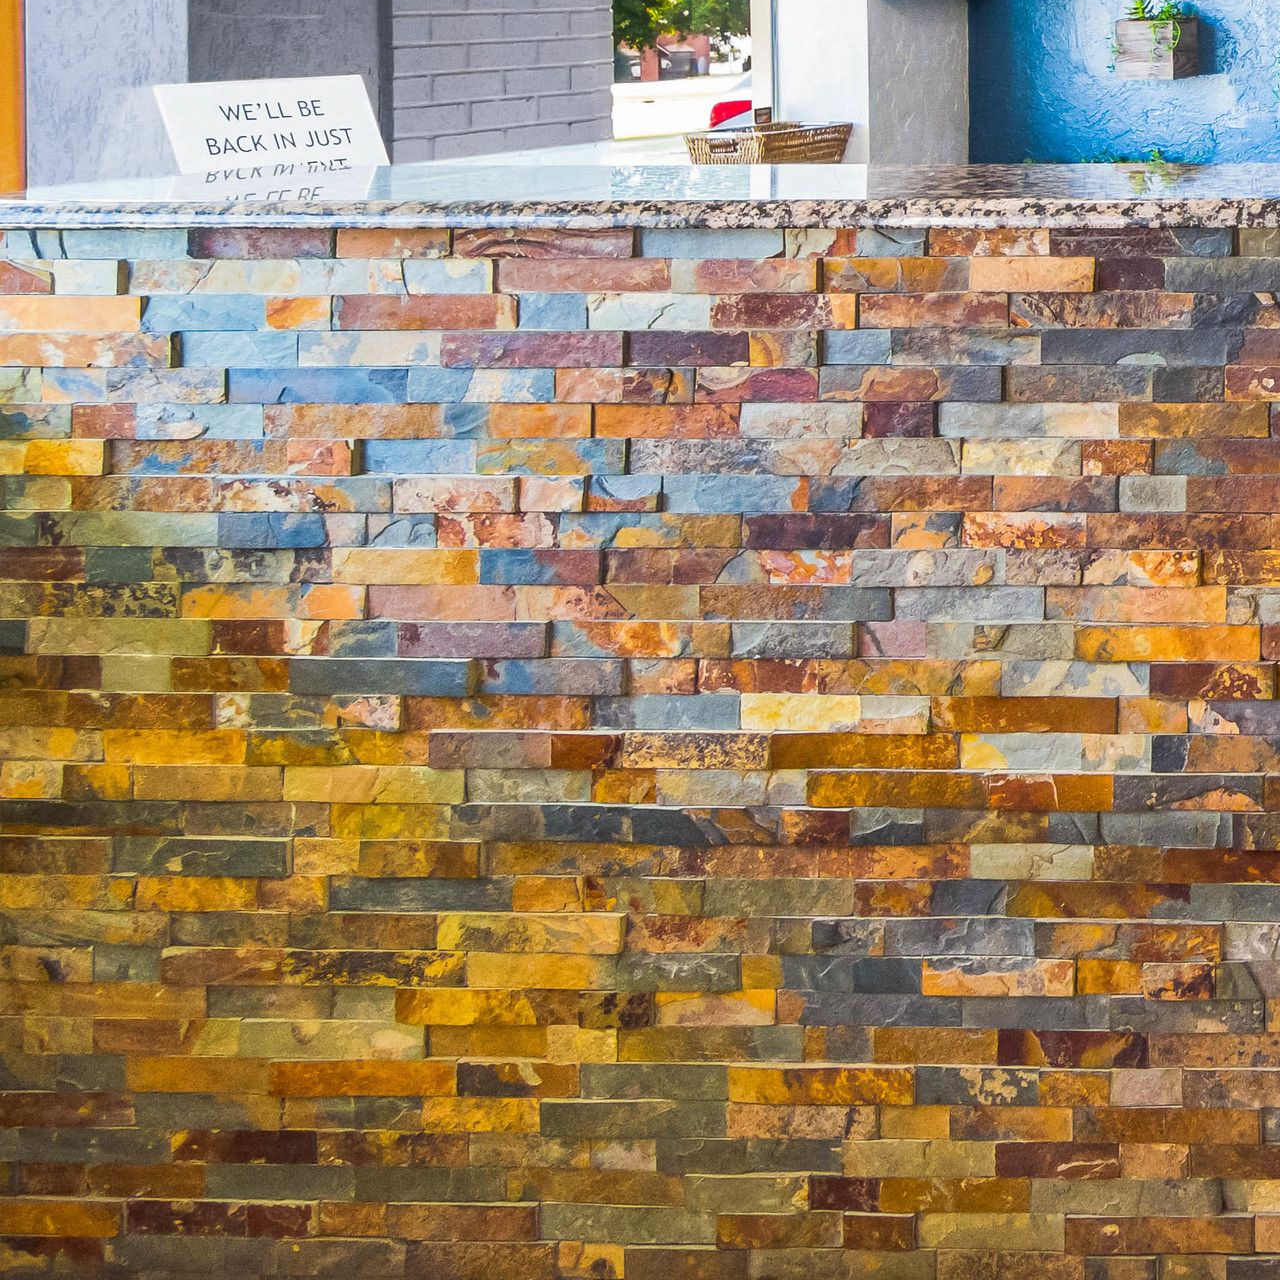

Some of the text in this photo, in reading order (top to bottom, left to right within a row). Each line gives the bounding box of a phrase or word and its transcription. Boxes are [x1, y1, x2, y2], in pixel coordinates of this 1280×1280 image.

[218, 99, 326, 122] WE'LL BE
[205, 127, 353, 156] BACK IN JUST
